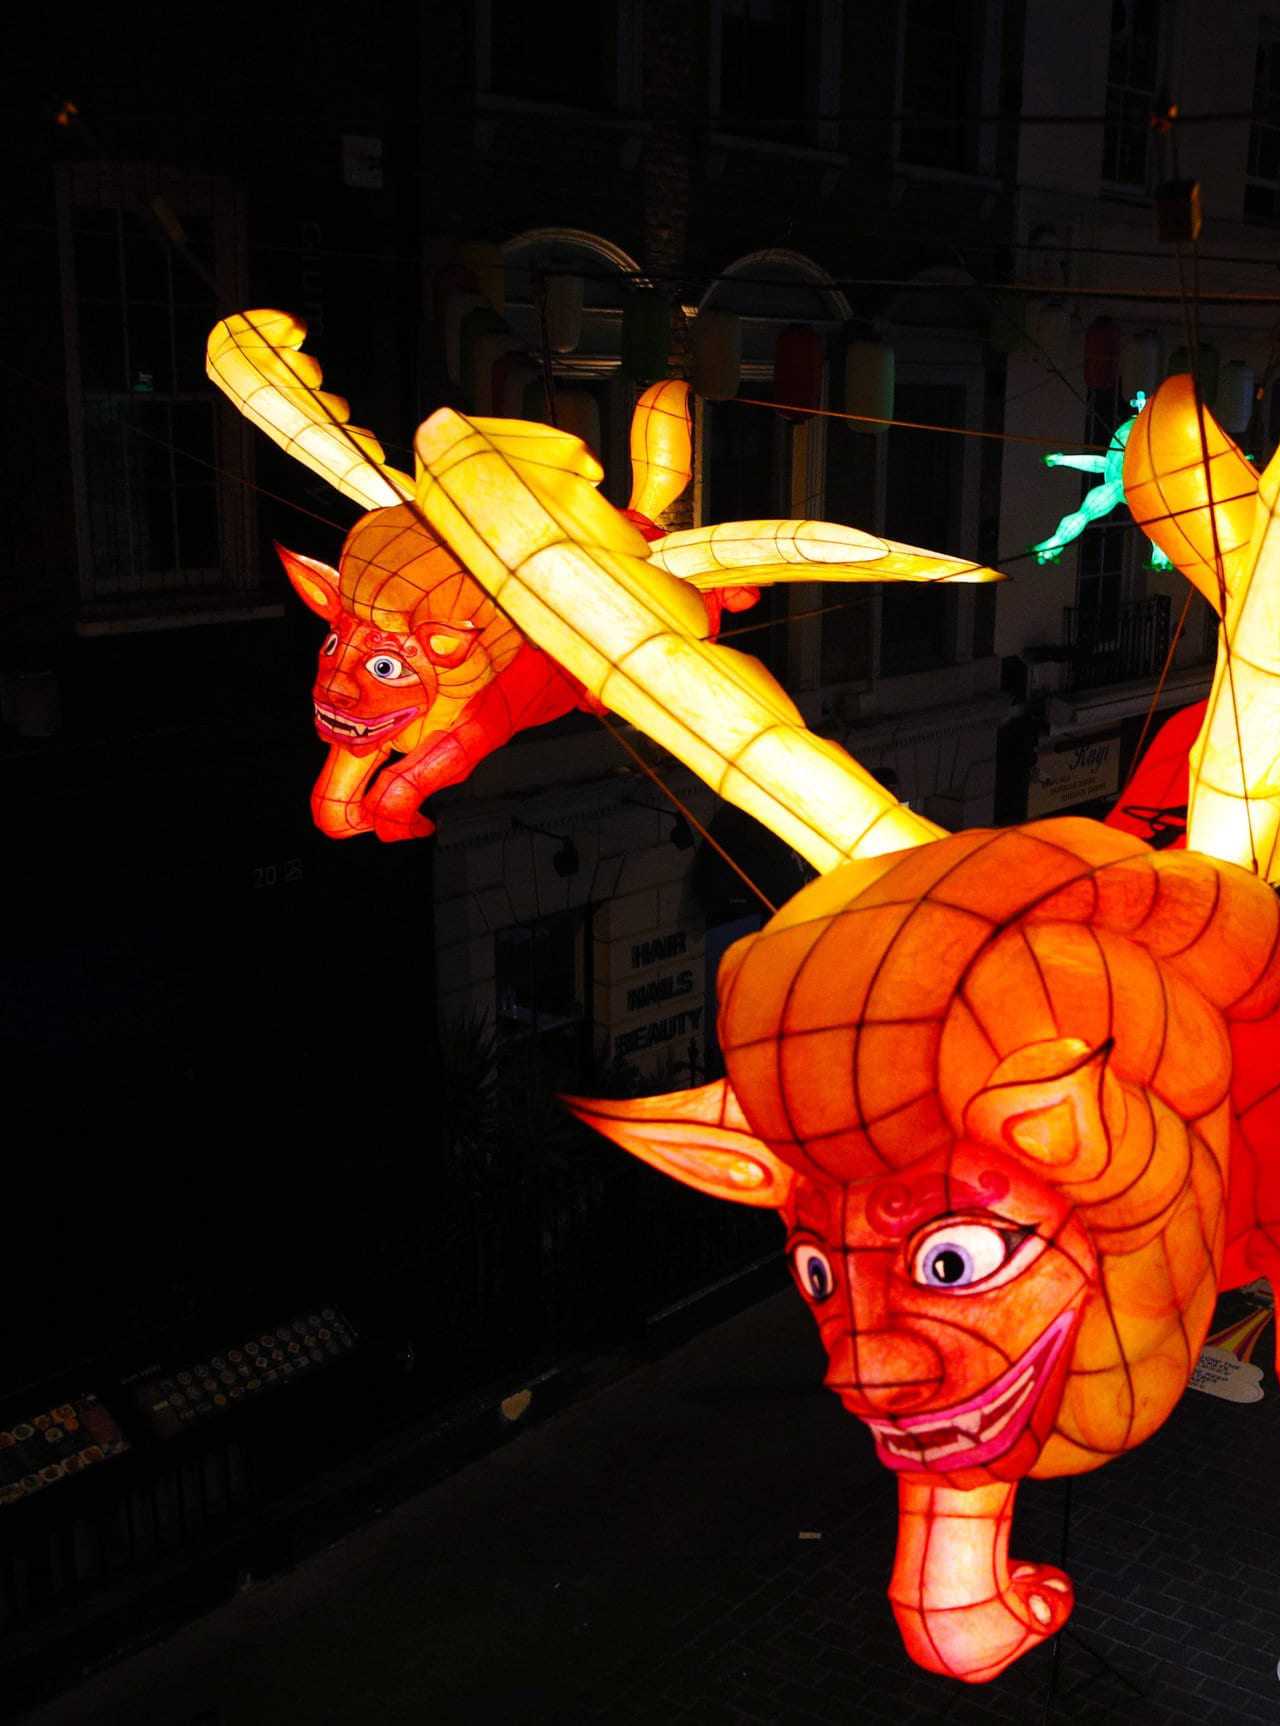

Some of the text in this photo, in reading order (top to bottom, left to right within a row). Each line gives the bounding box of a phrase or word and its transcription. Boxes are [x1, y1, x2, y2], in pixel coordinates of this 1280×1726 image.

[633, 931, 686, 968] HAIR
[627, 969, 694, 1010] NAILS
[615, 1006, 704, 1055] BEAUTY
